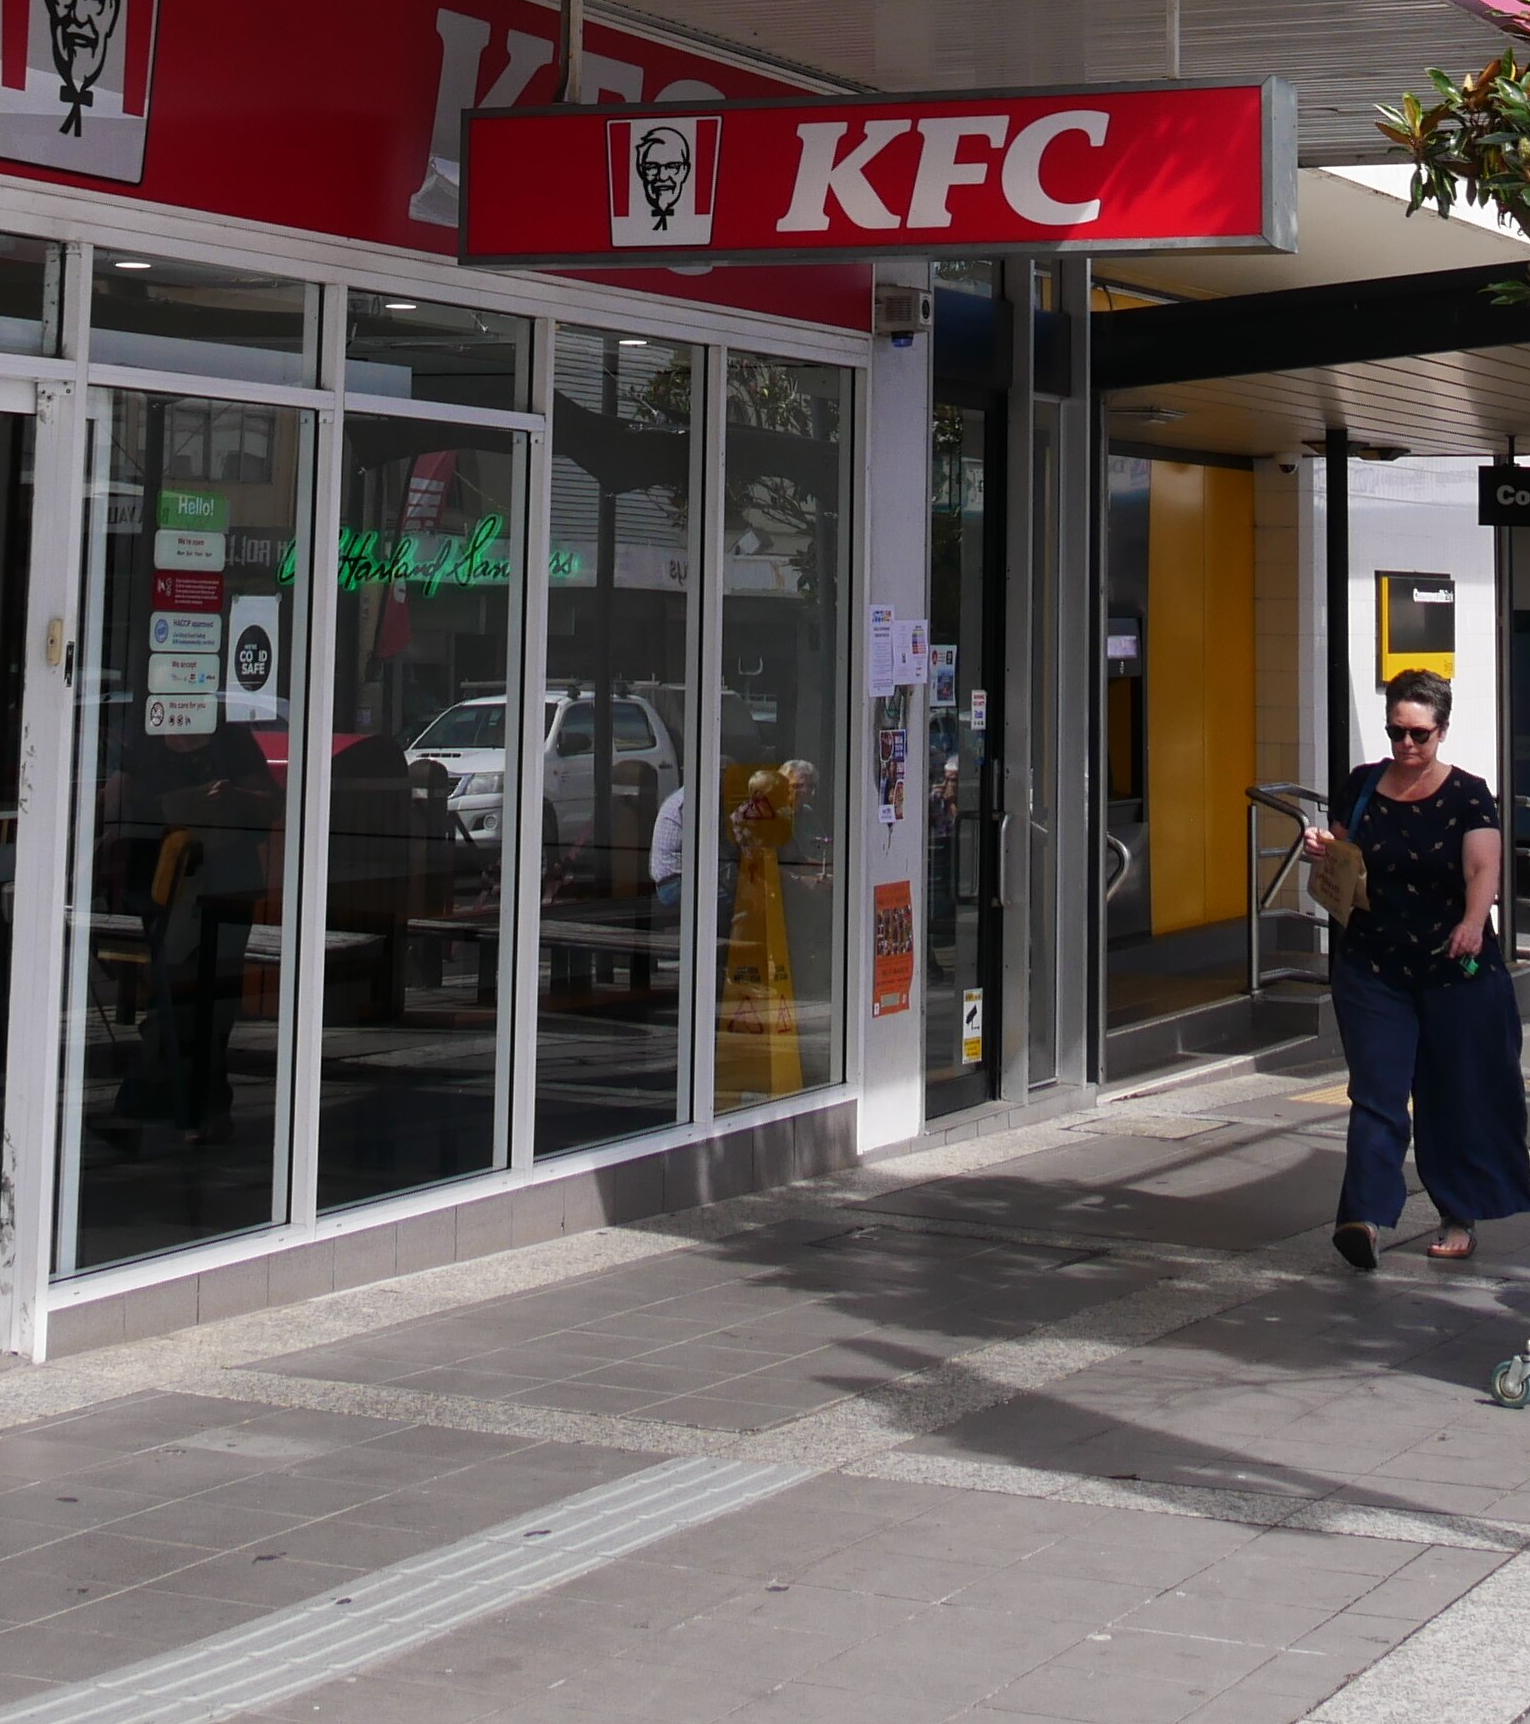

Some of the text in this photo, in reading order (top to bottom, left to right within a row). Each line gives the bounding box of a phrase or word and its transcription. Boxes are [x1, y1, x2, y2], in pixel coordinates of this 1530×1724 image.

[775, 109, 1111, 234] KFC
[178, 495, 215, 517] Hello!
[241, 662, 265, 676] SAFE
